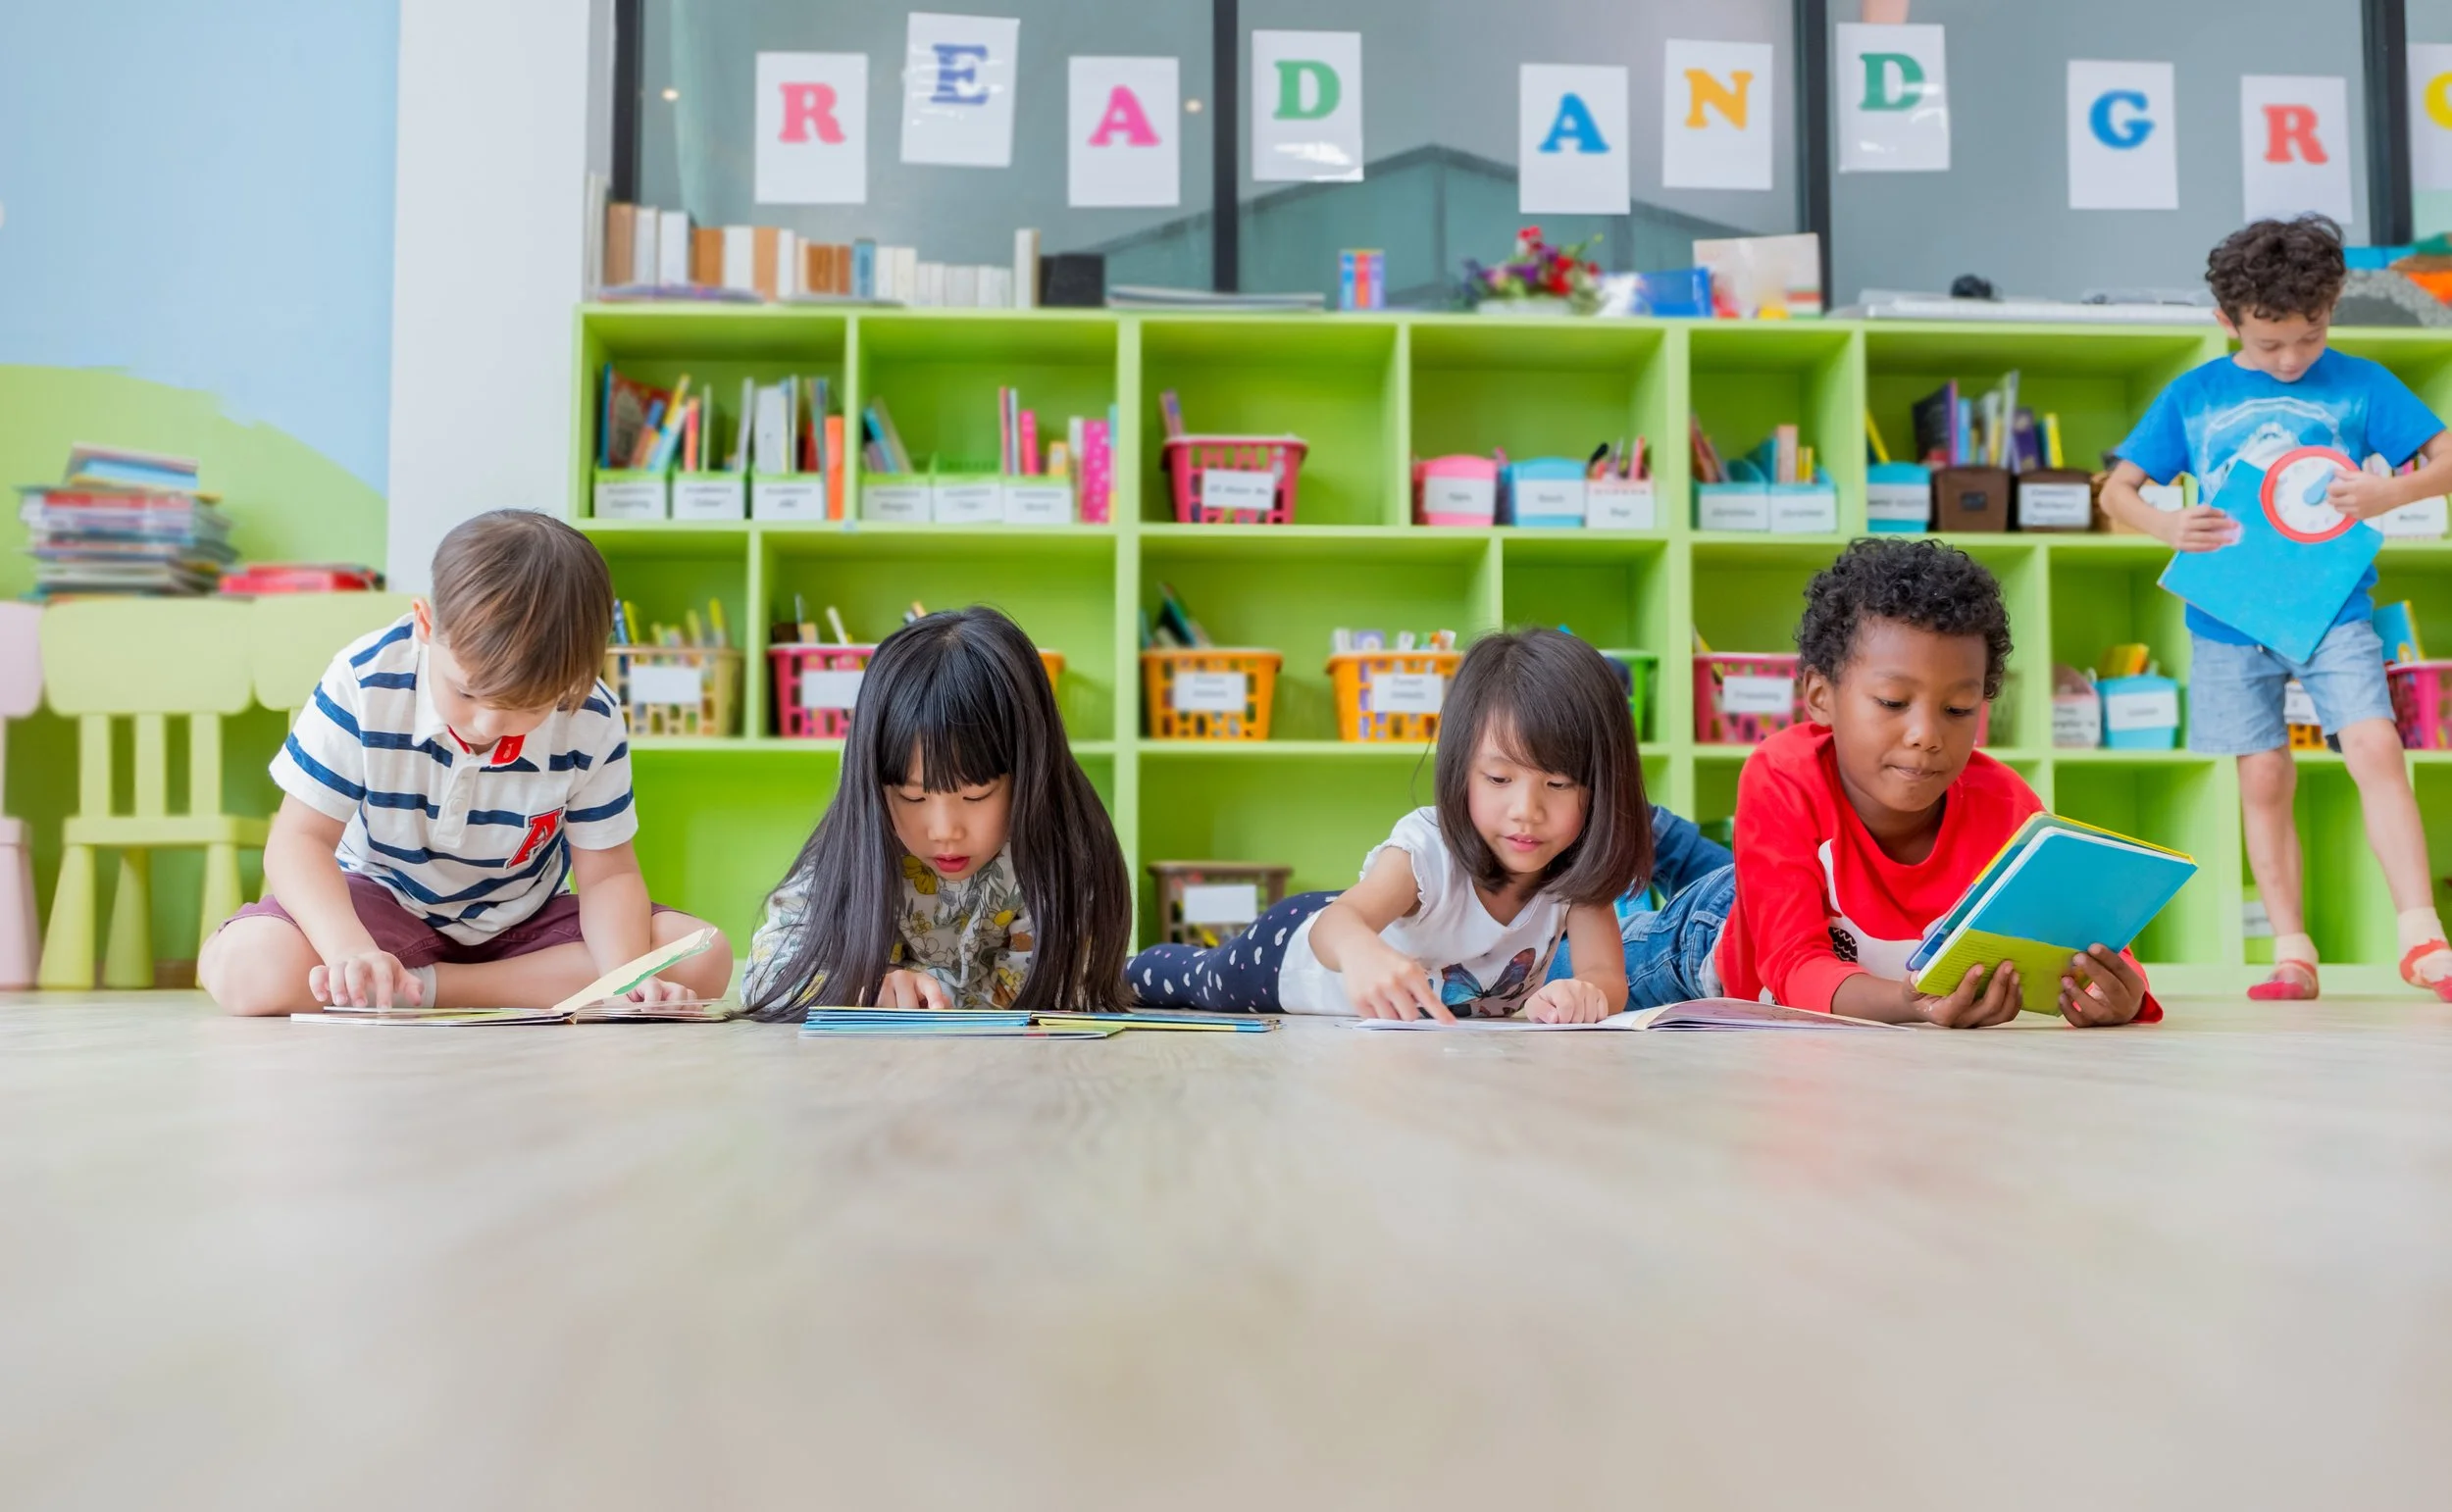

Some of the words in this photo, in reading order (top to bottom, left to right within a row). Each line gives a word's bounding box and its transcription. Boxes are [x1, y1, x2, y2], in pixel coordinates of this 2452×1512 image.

[782, 45, 1338, 145] READ
[1539, 53, 1923, 154] AND
[508, 807, 564, 869] A
